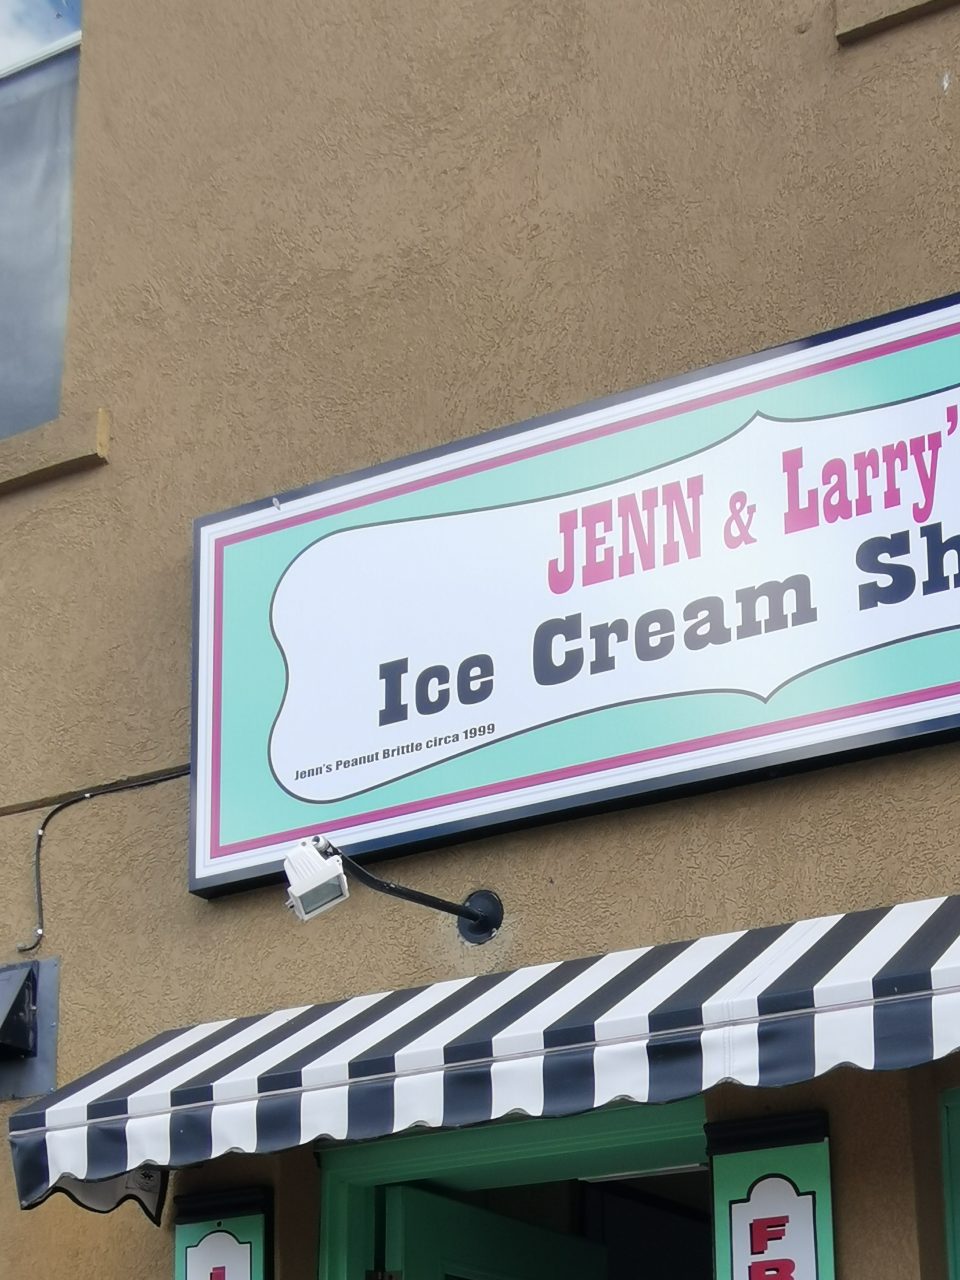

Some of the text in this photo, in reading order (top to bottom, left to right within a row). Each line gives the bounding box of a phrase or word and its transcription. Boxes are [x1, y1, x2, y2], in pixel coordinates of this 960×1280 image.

[548, 474, 704, 595] JENN
[723, 490, 757, 549] &
[379, 654, 494, 727] Ice
[532, 573, 818, 686] Cream
[294, 723, 496, 781] Jenn's Peanut Brittle circa 1999
